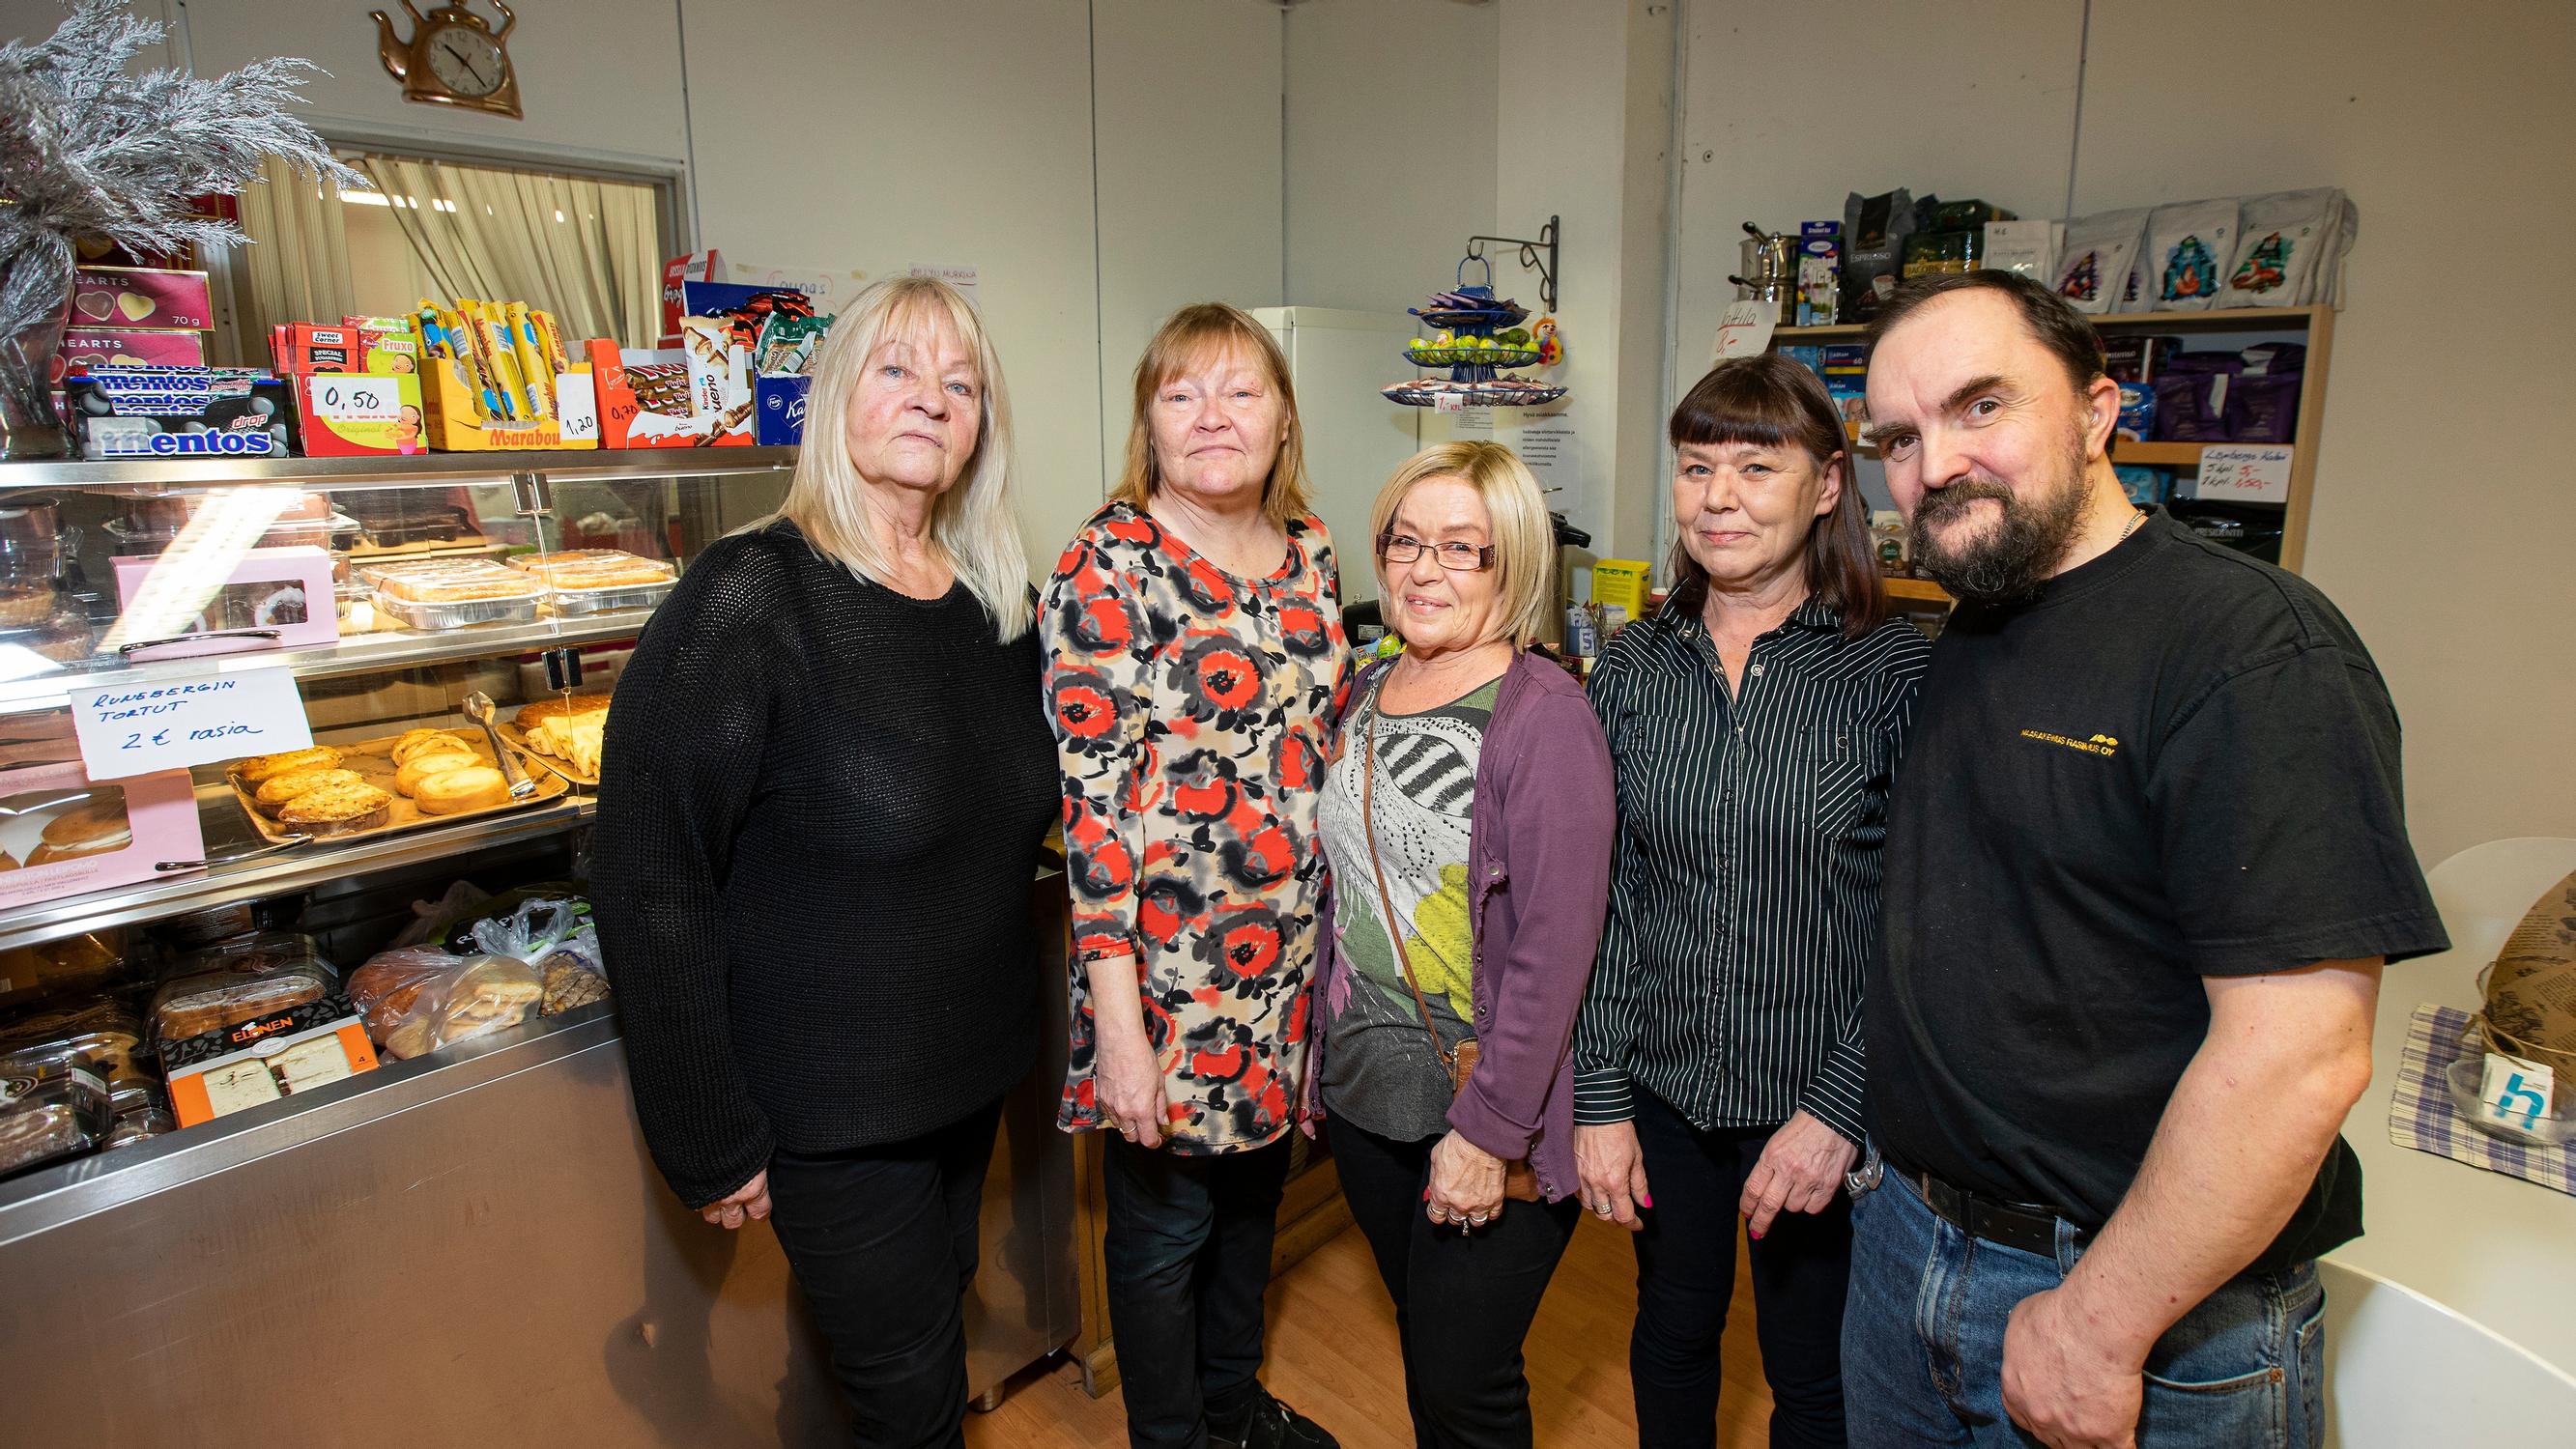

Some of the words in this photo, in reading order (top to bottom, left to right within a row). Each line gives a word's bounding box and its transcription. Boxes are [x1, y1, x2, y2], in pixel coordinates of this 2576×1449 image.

[75, 277, 130, 287] EARTS
[172, 315, 188, 325] 70
[191, 318, 200, 327] g
[383, 339, 414, 352] Fruxo
[326, 386, 380, 411] 0,50
[673, 391, 692, 401] Twi
[708, 374, 723, 412] ueno
[231, 413, 269, 429] drop
[612, 405, 639, 420] 0,70
[566, 415, 594, 436] 1,20
[490, 428, 560, 447] Marabou
[93, 680, 237, 708] RUNEBERGIN
[99, 700, 188, 724] TORTUT
[121, 733, 143, 750] 2
[151, 728, 171, 747] €
[188, 721, 264, 741] rasia
[2101, 747, 2115, 755] OY
[232, 1017, 294, 1043] ELONEN
